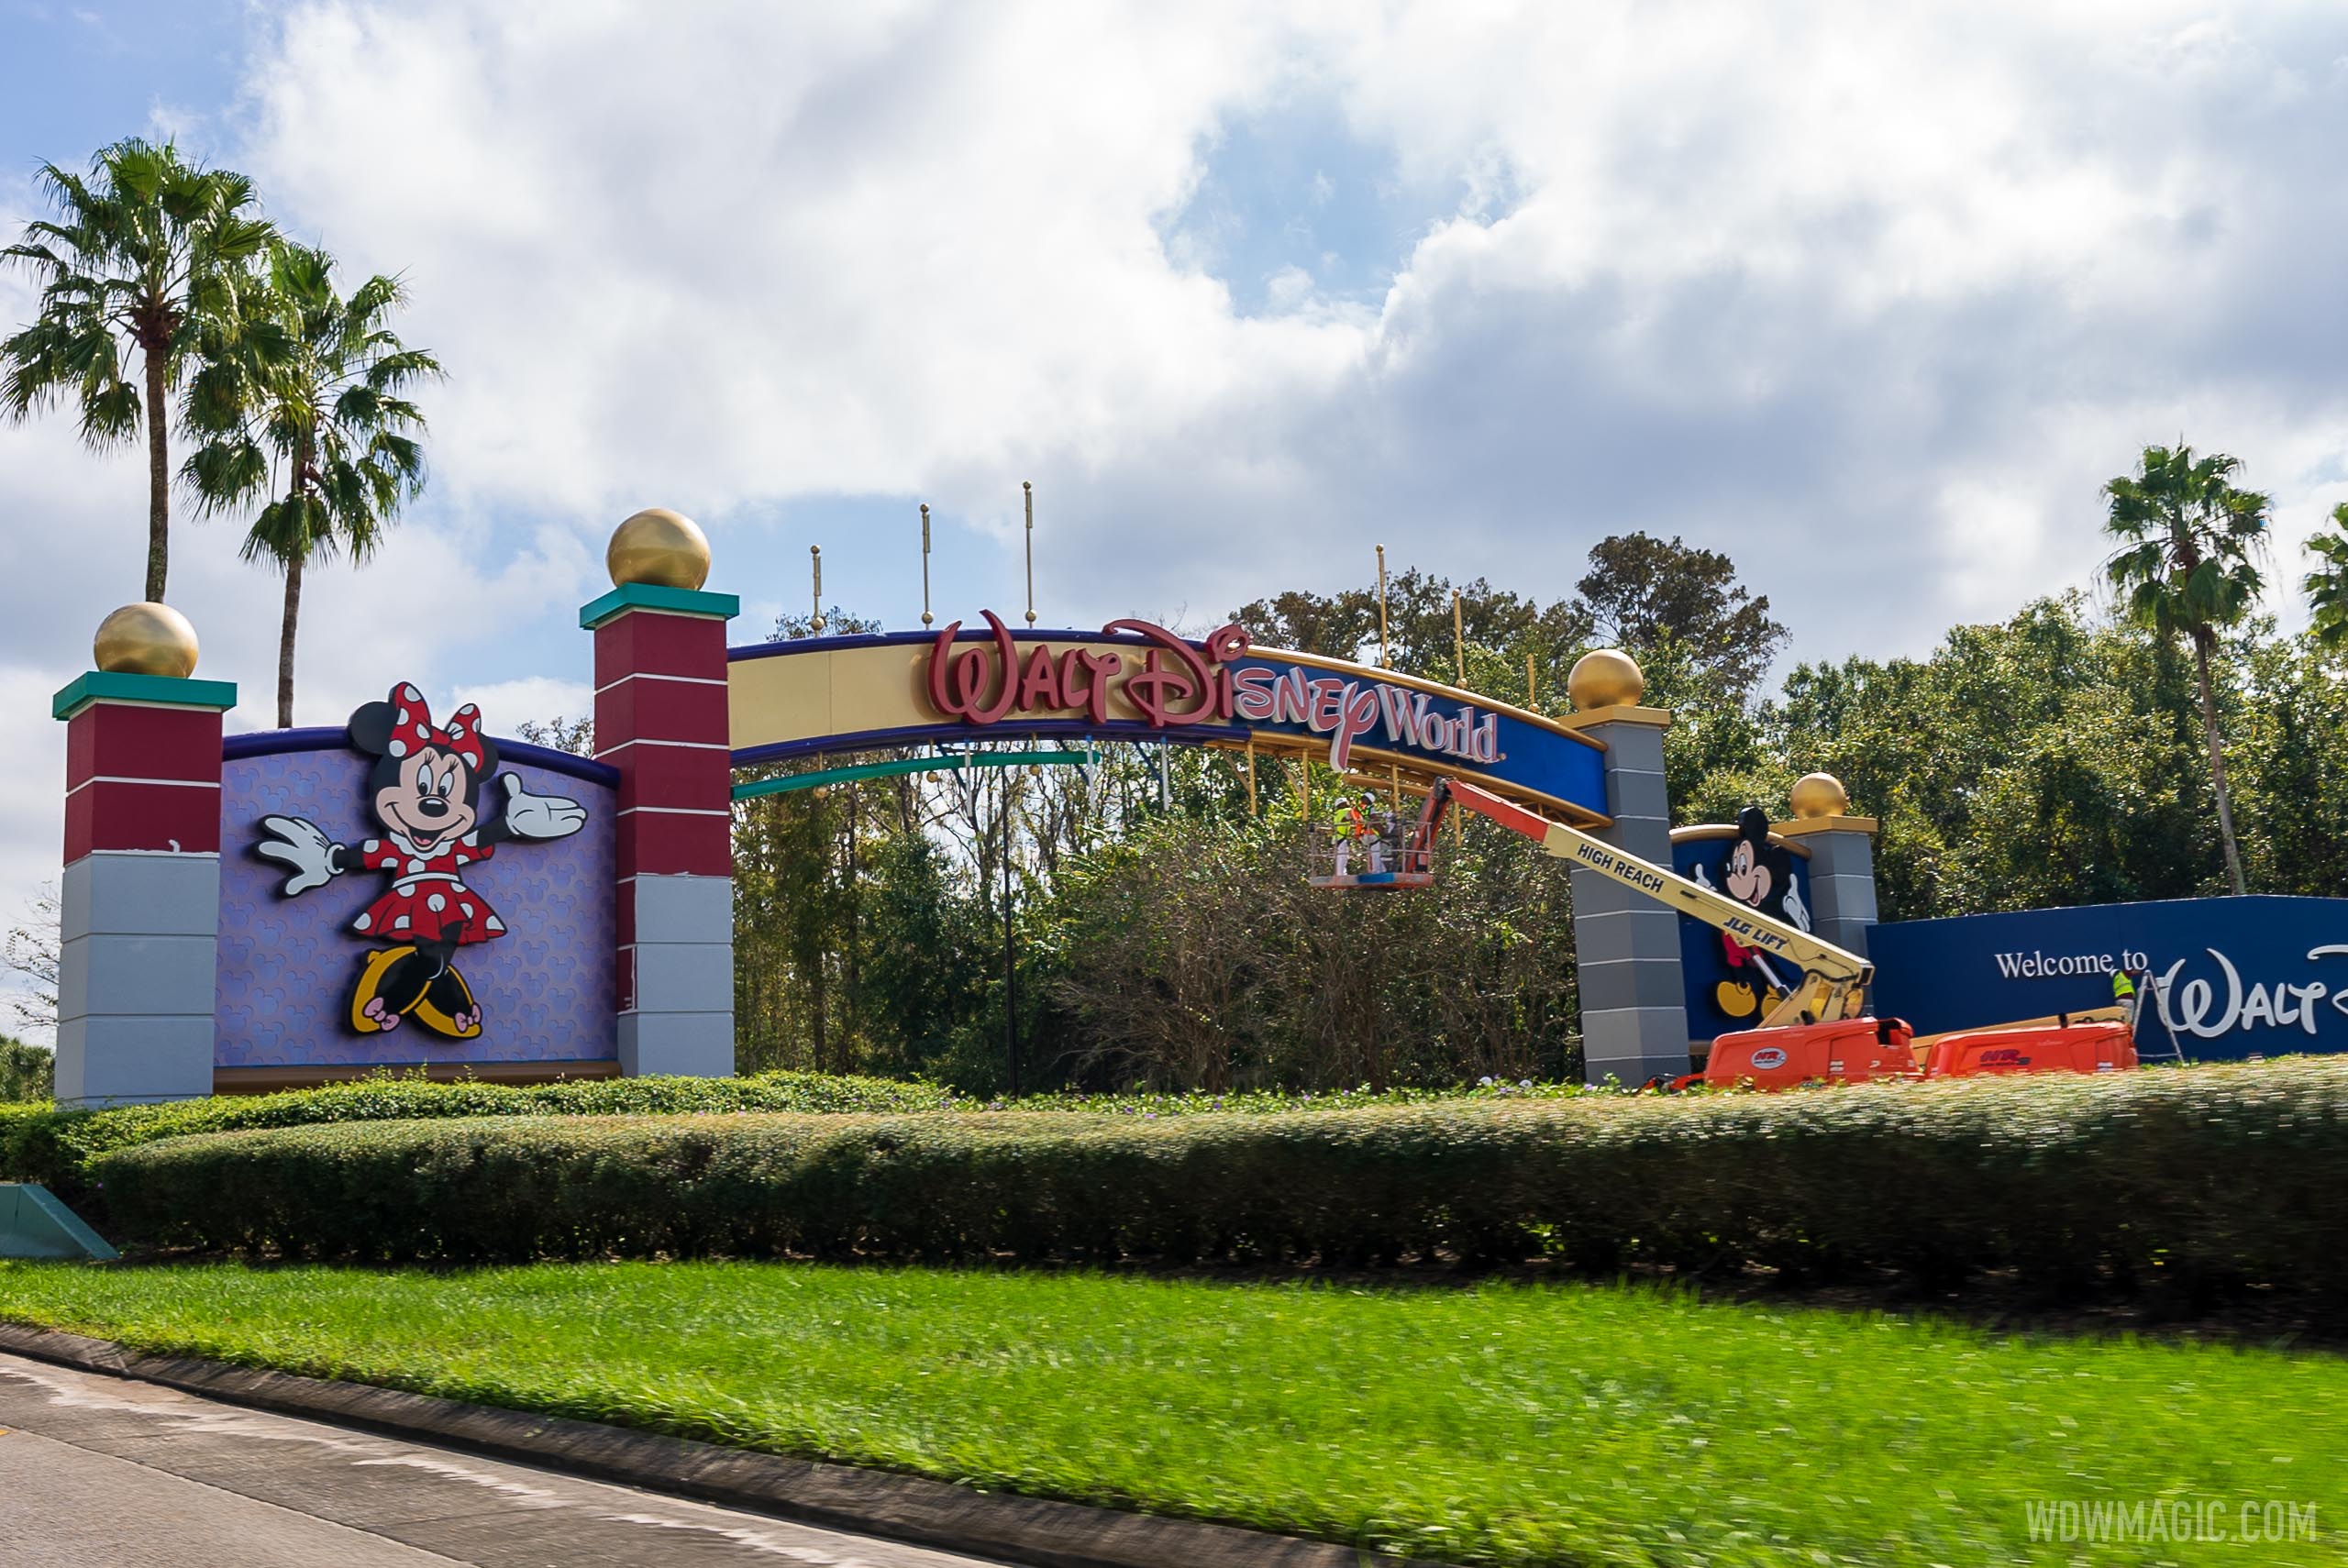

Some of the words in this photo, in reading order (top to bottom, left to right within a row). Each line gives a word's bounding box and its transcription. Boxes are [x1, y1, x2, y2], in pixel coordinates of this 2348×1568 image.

[927, 608, 1122, 725] WALT
[1373, 682, 1501, 765] World
[1577, 843, 1614, 869] HIGH
[1614, 860, 1665, 893] REACH
[1722, 916, 1751, 935] JLG
[1753, 927, 1789, 951] LIFT
[1994, 949, 2114, 979] Welcome
[2121, 948, 2148, 971] to
[2156, 947, 2328, 1038] WALT
